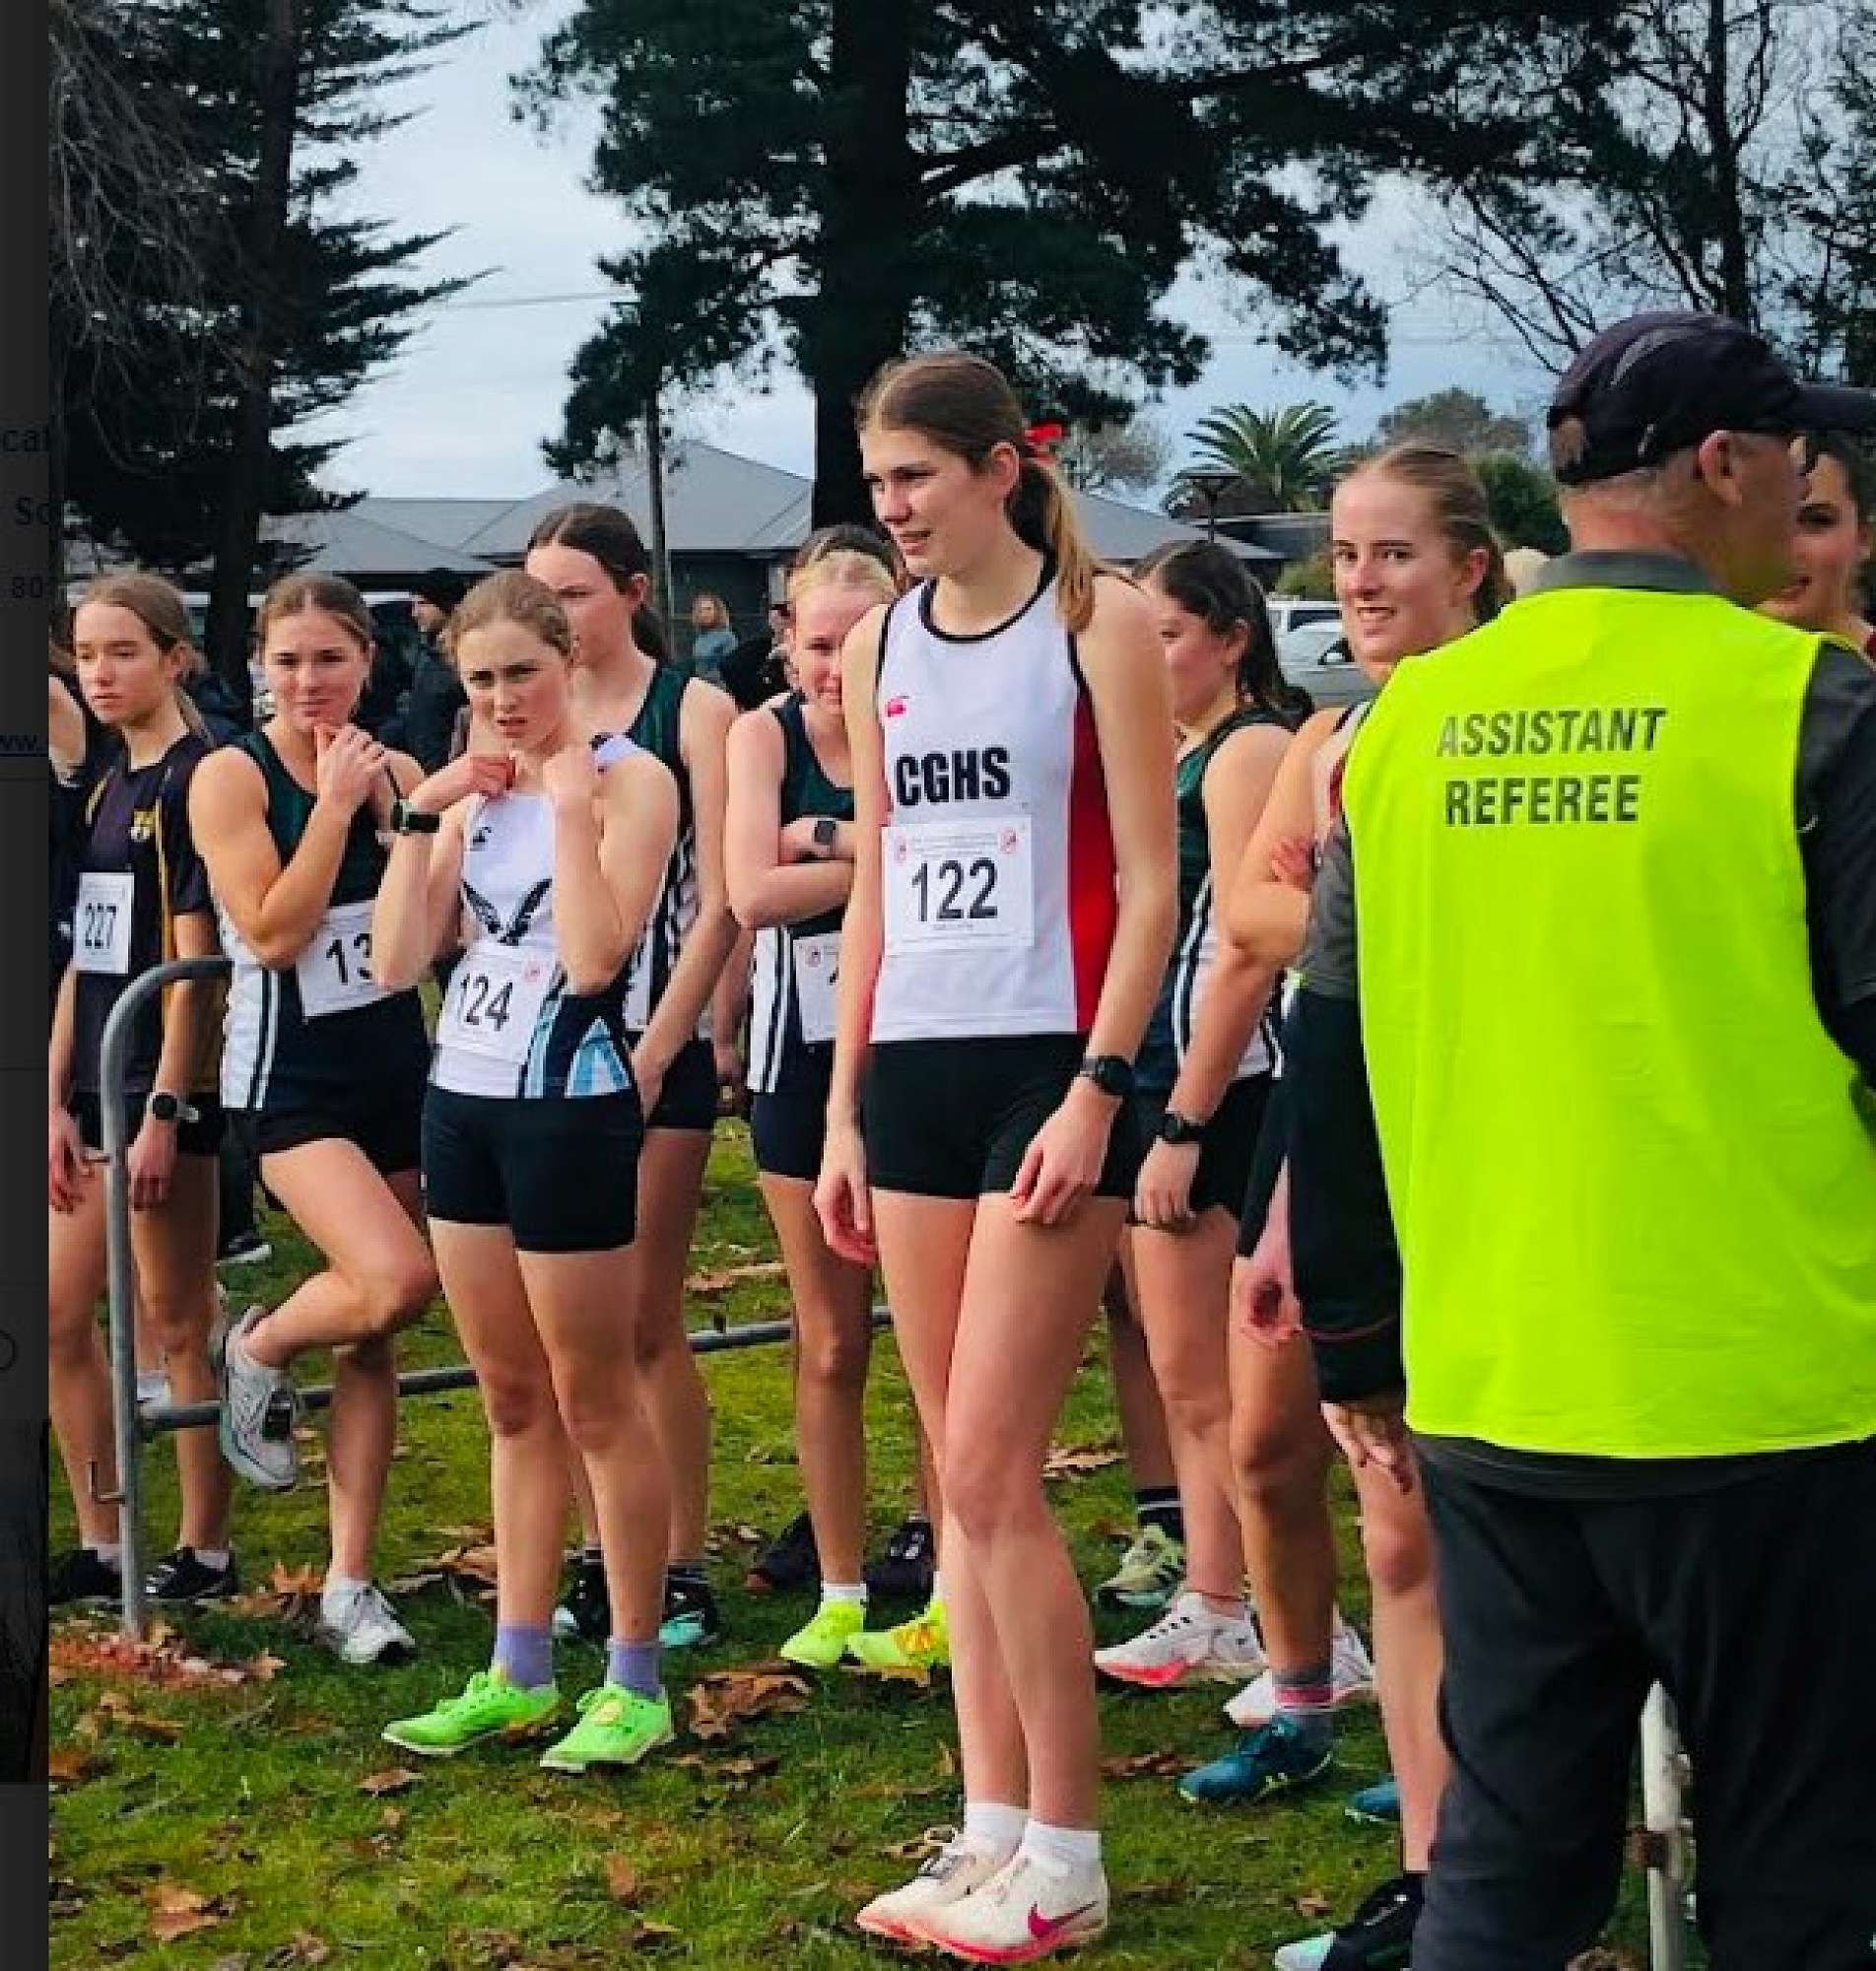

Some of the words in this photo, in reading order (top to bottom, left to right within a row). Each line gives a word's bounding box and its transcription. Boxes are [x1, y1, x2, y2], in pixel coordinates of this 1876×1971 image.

[1437, 708, 1667, 757] ASSISTANT
[896, 747, 1010, 805] CGHS
[1444, 775, 1640, 827] REFEREE
[911, 857, 998, 921] 122
[85, 902, 117, 949] 227
[456, 972, 513, 1032] 124
